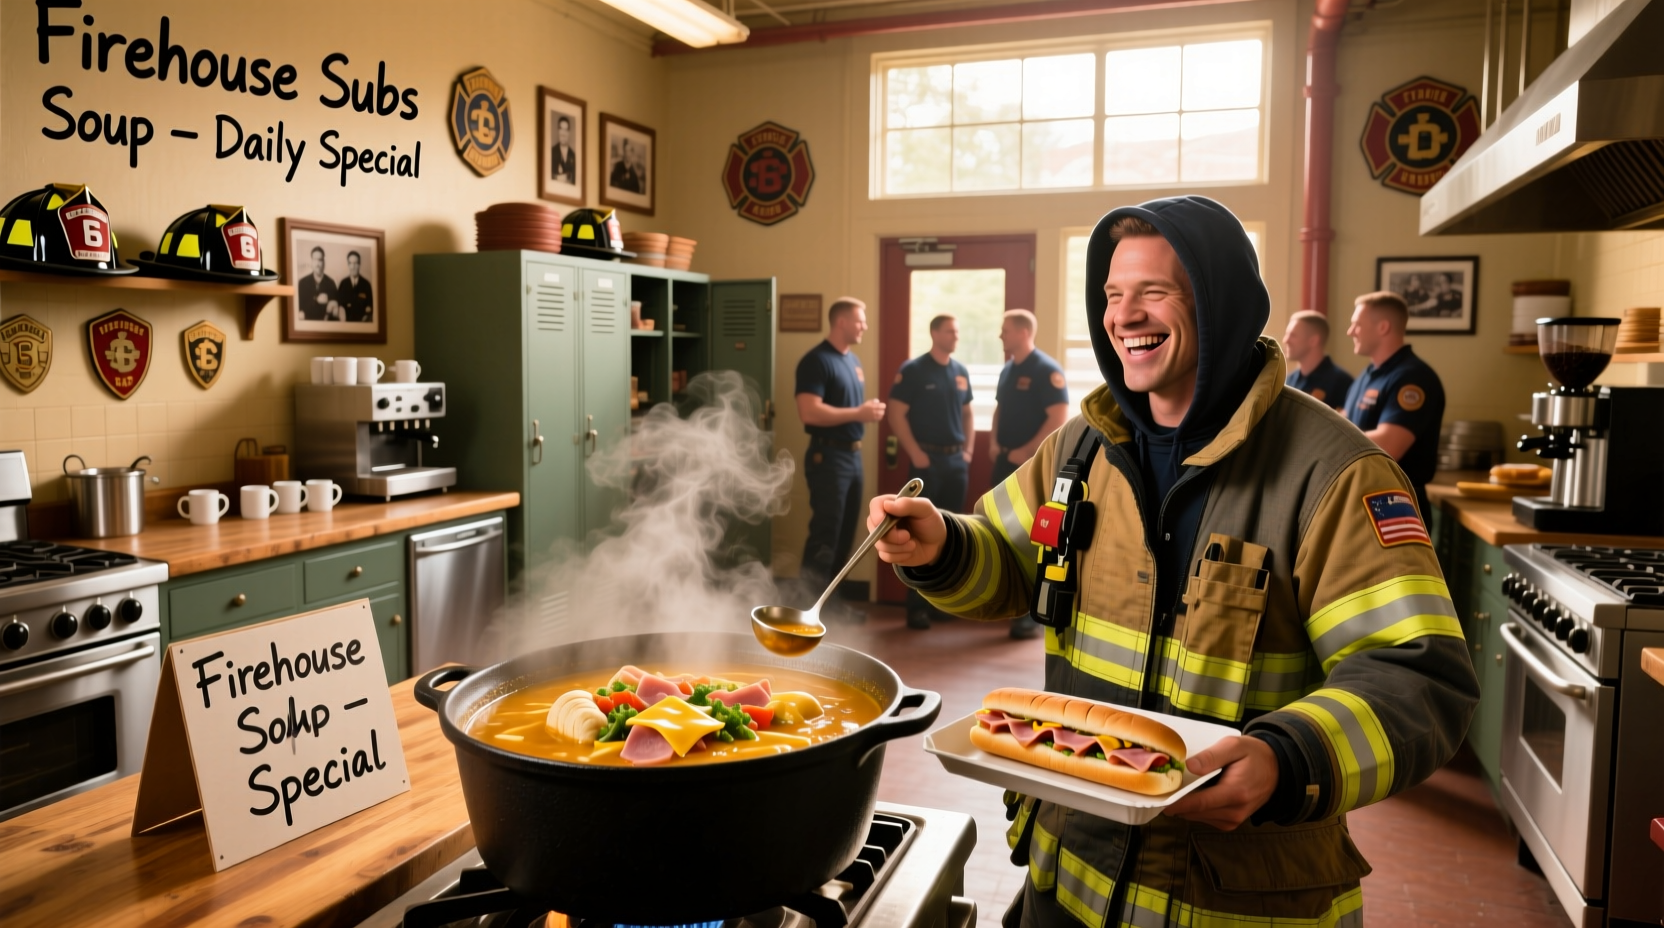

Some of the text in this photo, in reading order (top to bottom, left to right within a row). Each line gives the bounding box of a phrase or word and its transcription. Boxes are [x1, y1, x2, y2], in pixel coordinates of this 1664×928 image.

[35, 0, 420, 121] Firehouse Subs
[41, 85, 154, 168] Soup
[214, 114, 306, 183] Daily
[318, 128, 421, 187] Special
[82, 219, 104, 247] 6
[192, 639, 366, 709] Firehouse
[248, 729, 388, 827] Special
